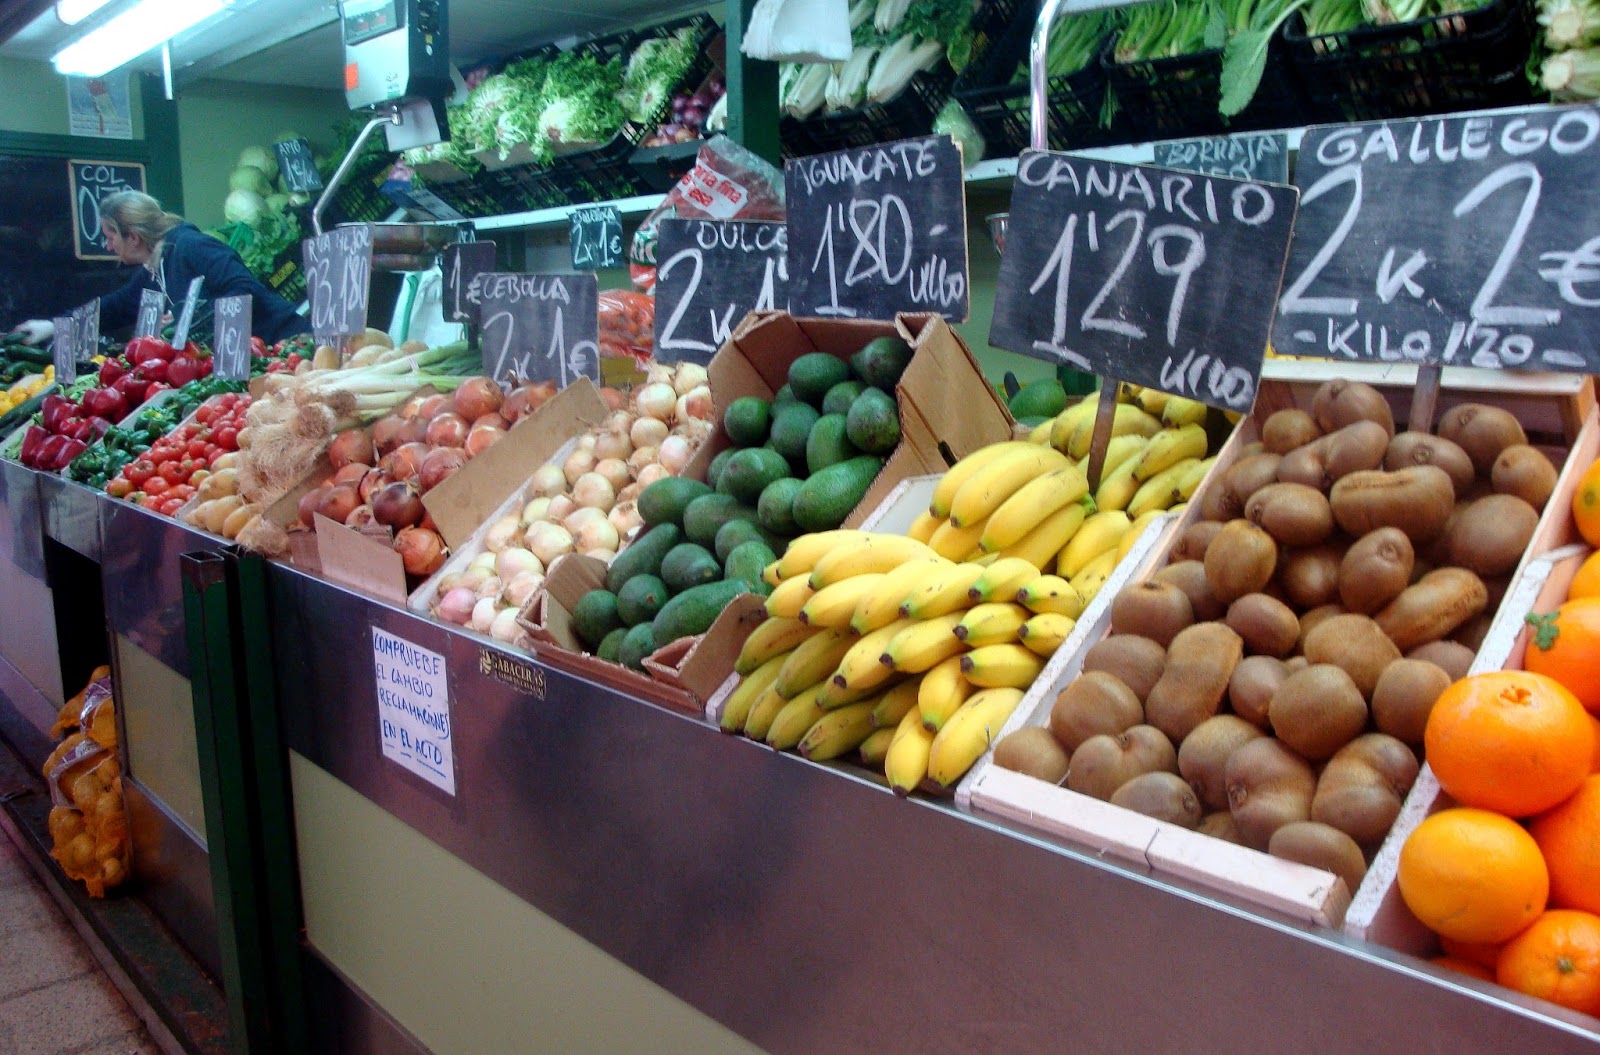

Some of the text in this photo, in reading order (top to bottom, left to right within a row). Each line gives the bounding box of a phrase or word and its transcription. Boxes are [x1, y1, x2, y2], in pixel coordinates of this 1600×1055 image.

[1317, 110, 1600, 166] GALLEGO
[80, 165, 125, 185] COL
[794, 139, 938, 196] AGUACATE
[1018, 151, 1275, 227] CANARIO
[717, 180, 742, 205] fina
[483, 275, 571, 304] CEBOLLA
[374, 633, 442, 676] COMPRUEBE
[376, 663, 433, 698] EL CAMBIO
[379, 687, 450, 740] RECLAMACIONES
[383, 719, 443, 765] EN EL ACTO
